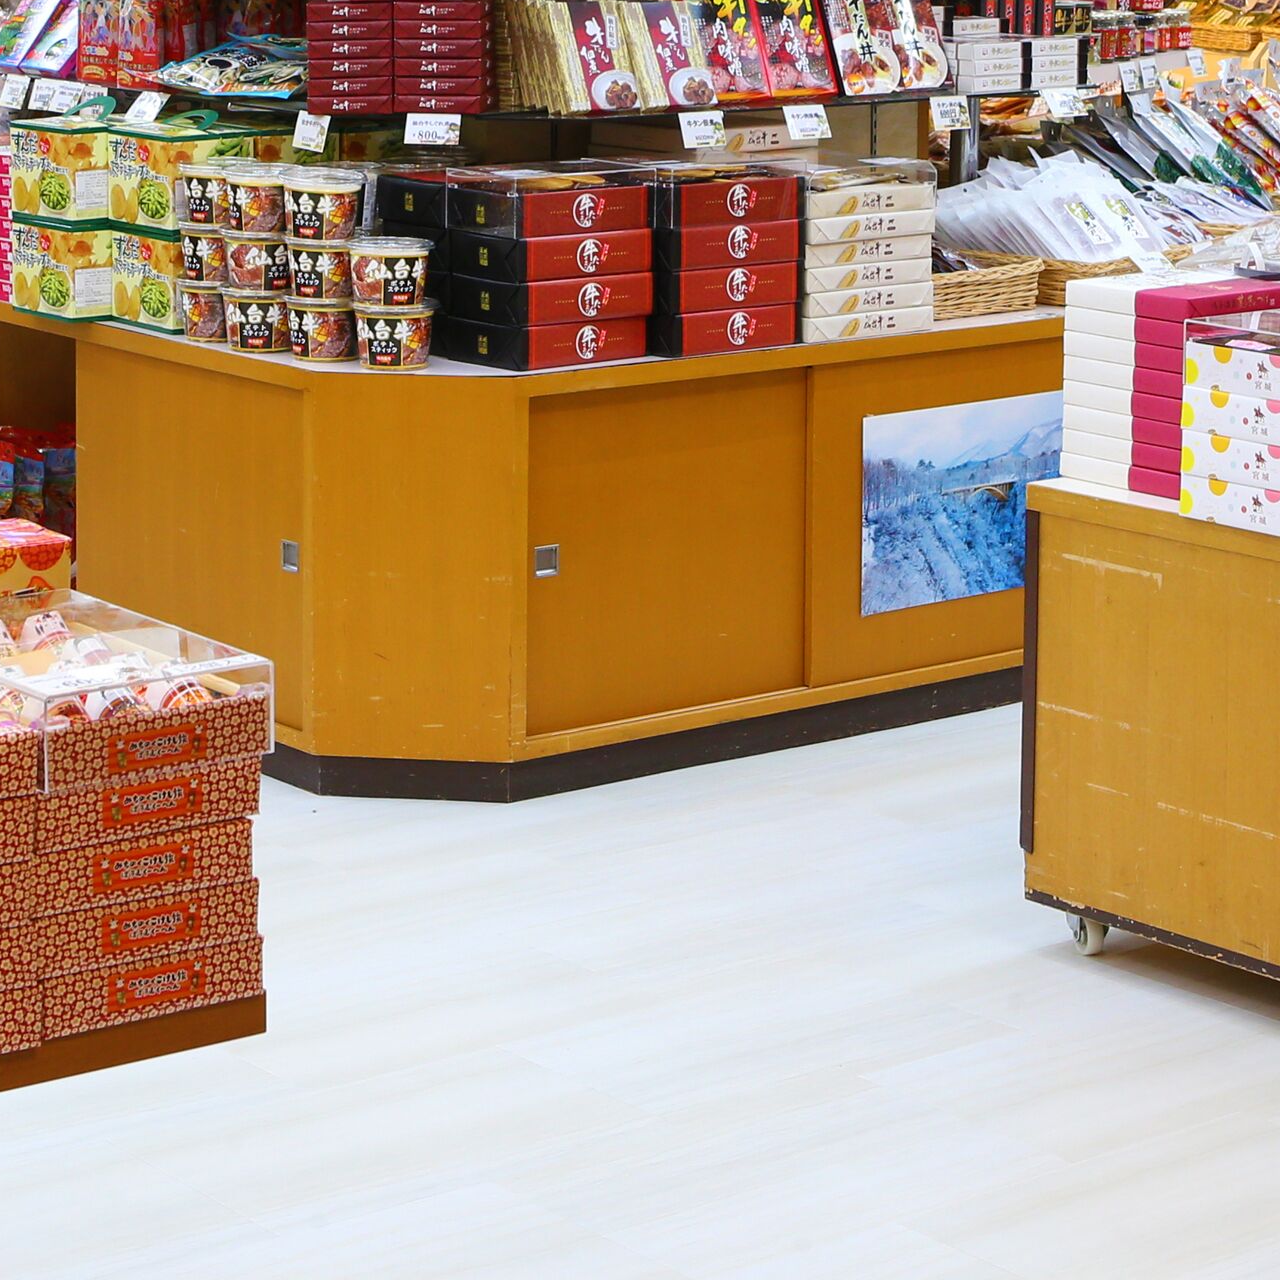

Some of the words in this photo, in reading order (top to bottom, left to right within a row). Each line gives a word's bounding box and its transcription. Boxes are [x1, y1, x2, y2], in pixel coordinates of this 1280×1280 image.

[711, 17, 744, 77] 肉味噌
[779, 17, 809, 76] 肉味噌
